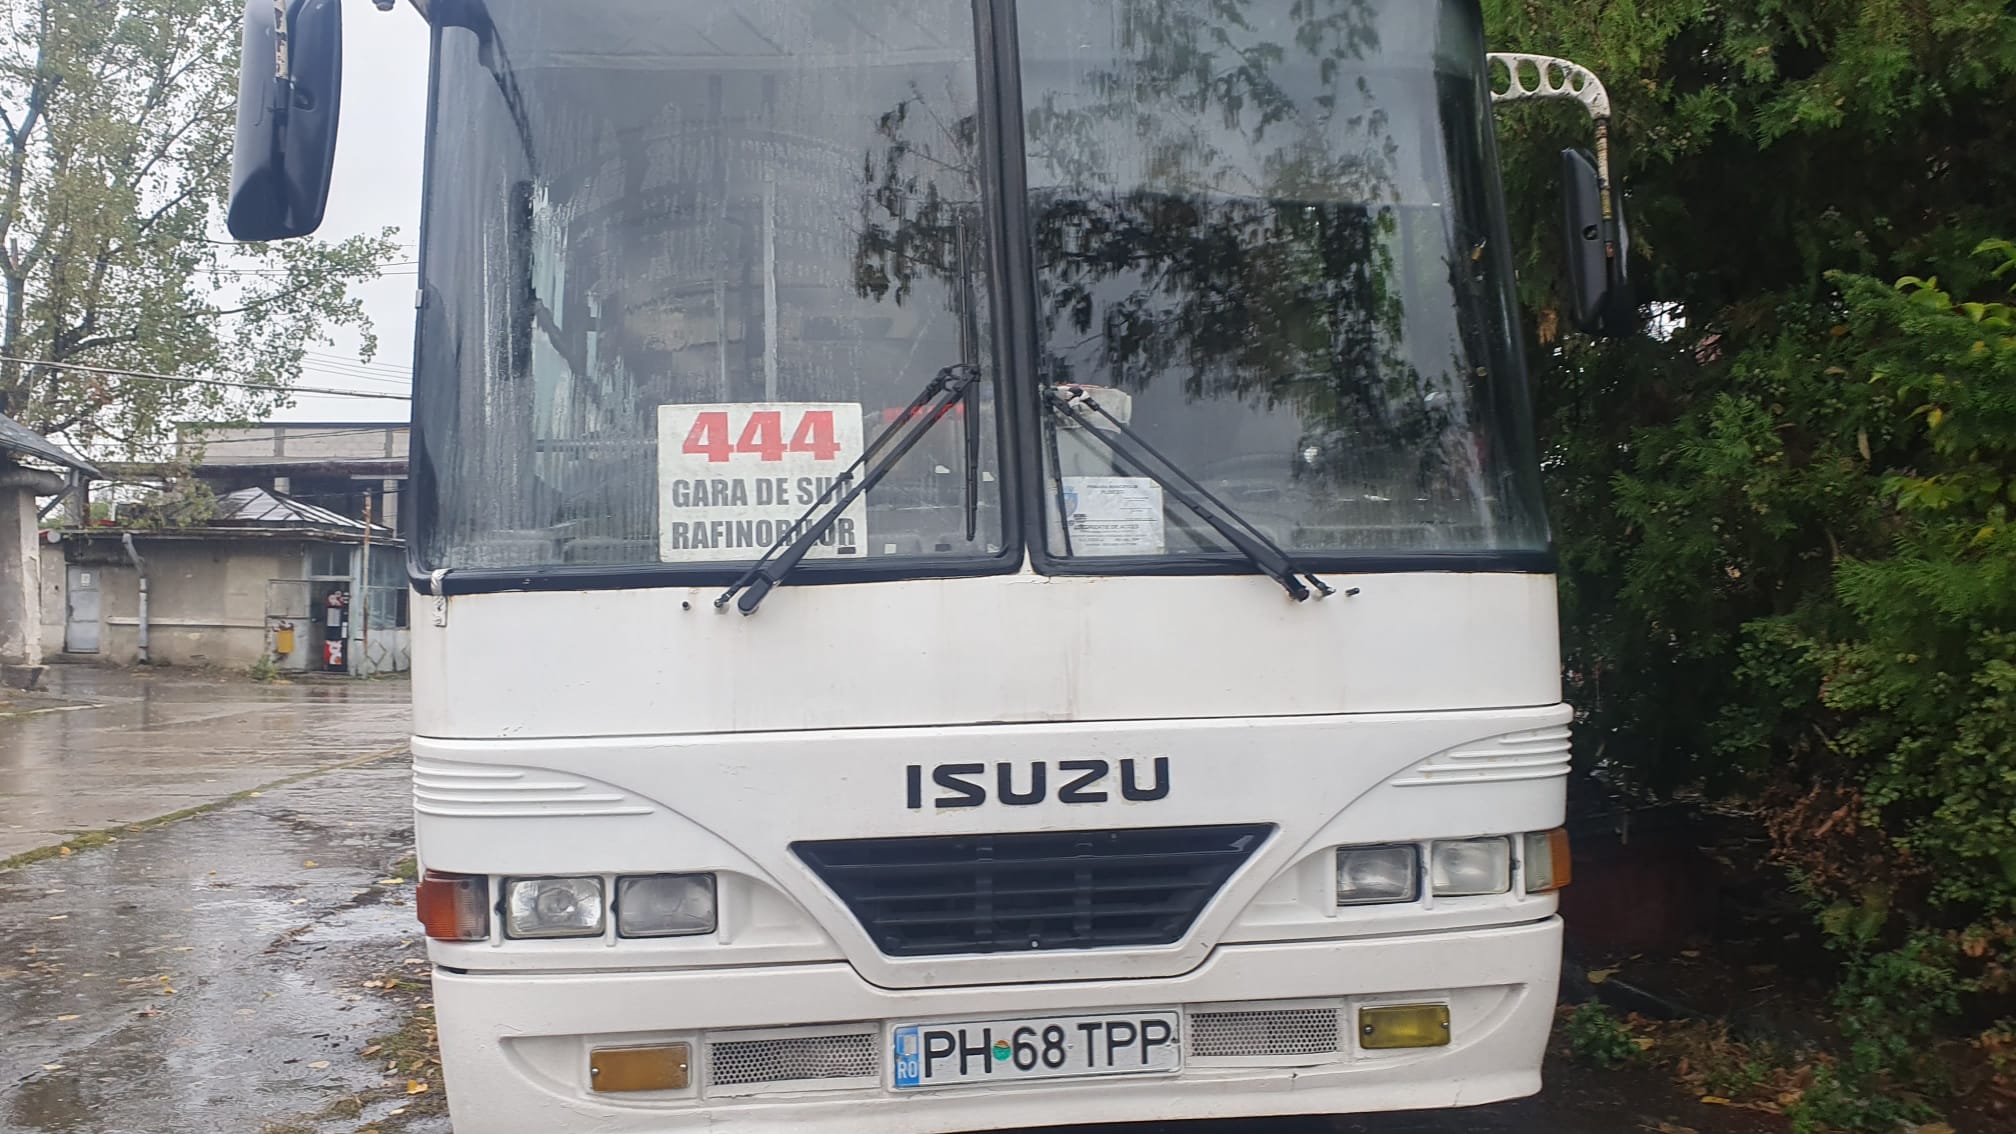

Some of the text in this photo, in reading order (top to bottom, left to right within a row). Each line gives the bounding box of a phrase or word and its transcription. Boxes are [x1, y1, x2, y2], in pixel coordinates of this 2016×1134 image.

[681, 410, 842, 463] 444
[672, 478, 748, 508] GARA
[756, 477, 790, 506] DE
[906, 756, 1170, 809] ISUZU
[898, 1061, 918, 1079] RO
[923, 1019, 1172, 1078] PH 68 TPP
